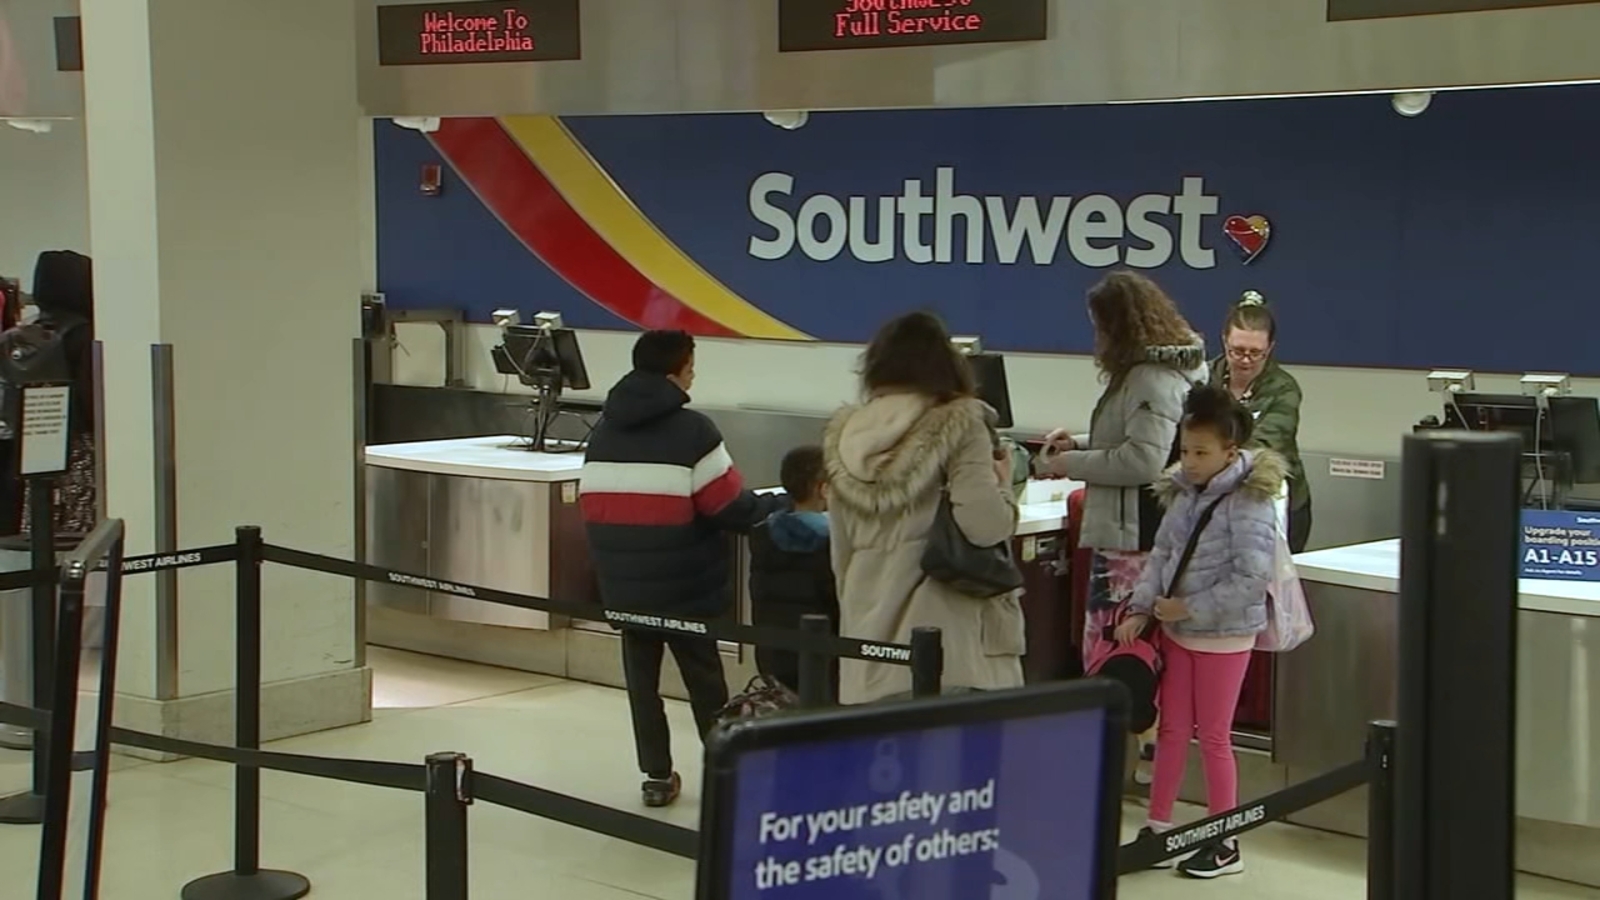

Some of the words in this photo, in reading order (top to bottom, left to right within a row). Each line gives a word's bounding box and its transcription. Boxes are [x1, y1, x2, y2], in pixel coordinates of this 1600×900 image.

[424, 12, 498, 32] Welcome
[503, 9, 528, 30] To
[834, 12, 880, 37] Full
[887, 10, 981, 34] Service
[420, 30, 534, 54] Philadelphia
[748, 166, 1219, 269] Southwest
[155, 552, 201, 568] AIRLINES
[1524, 548, 1598, 566] A1-A15
[388, 572, 438, 590] SOUTHWEST
[439, 581, 476, 597] AIRLINES
[604, 609, 663, 628] SOUTHWEST
[663, 618, 707, 634] AIRLINES
[860, 643, 911, 661] SOUTHW
[759, 812, 802, 844] For
[806, 803, 865, 845] your
[871, 790, 946, 826] safety
[948, 779, 995, 811] and
[1166, 818, 1226, 852] SOUTHWEST
[1224, 804, 1266, 833] AIRLINES
[754, 858, 801, 890] the
[803, 844, 882, 881] safety
[884, 833, 915, 867] of
[914, 825, 1000, 862] others:
